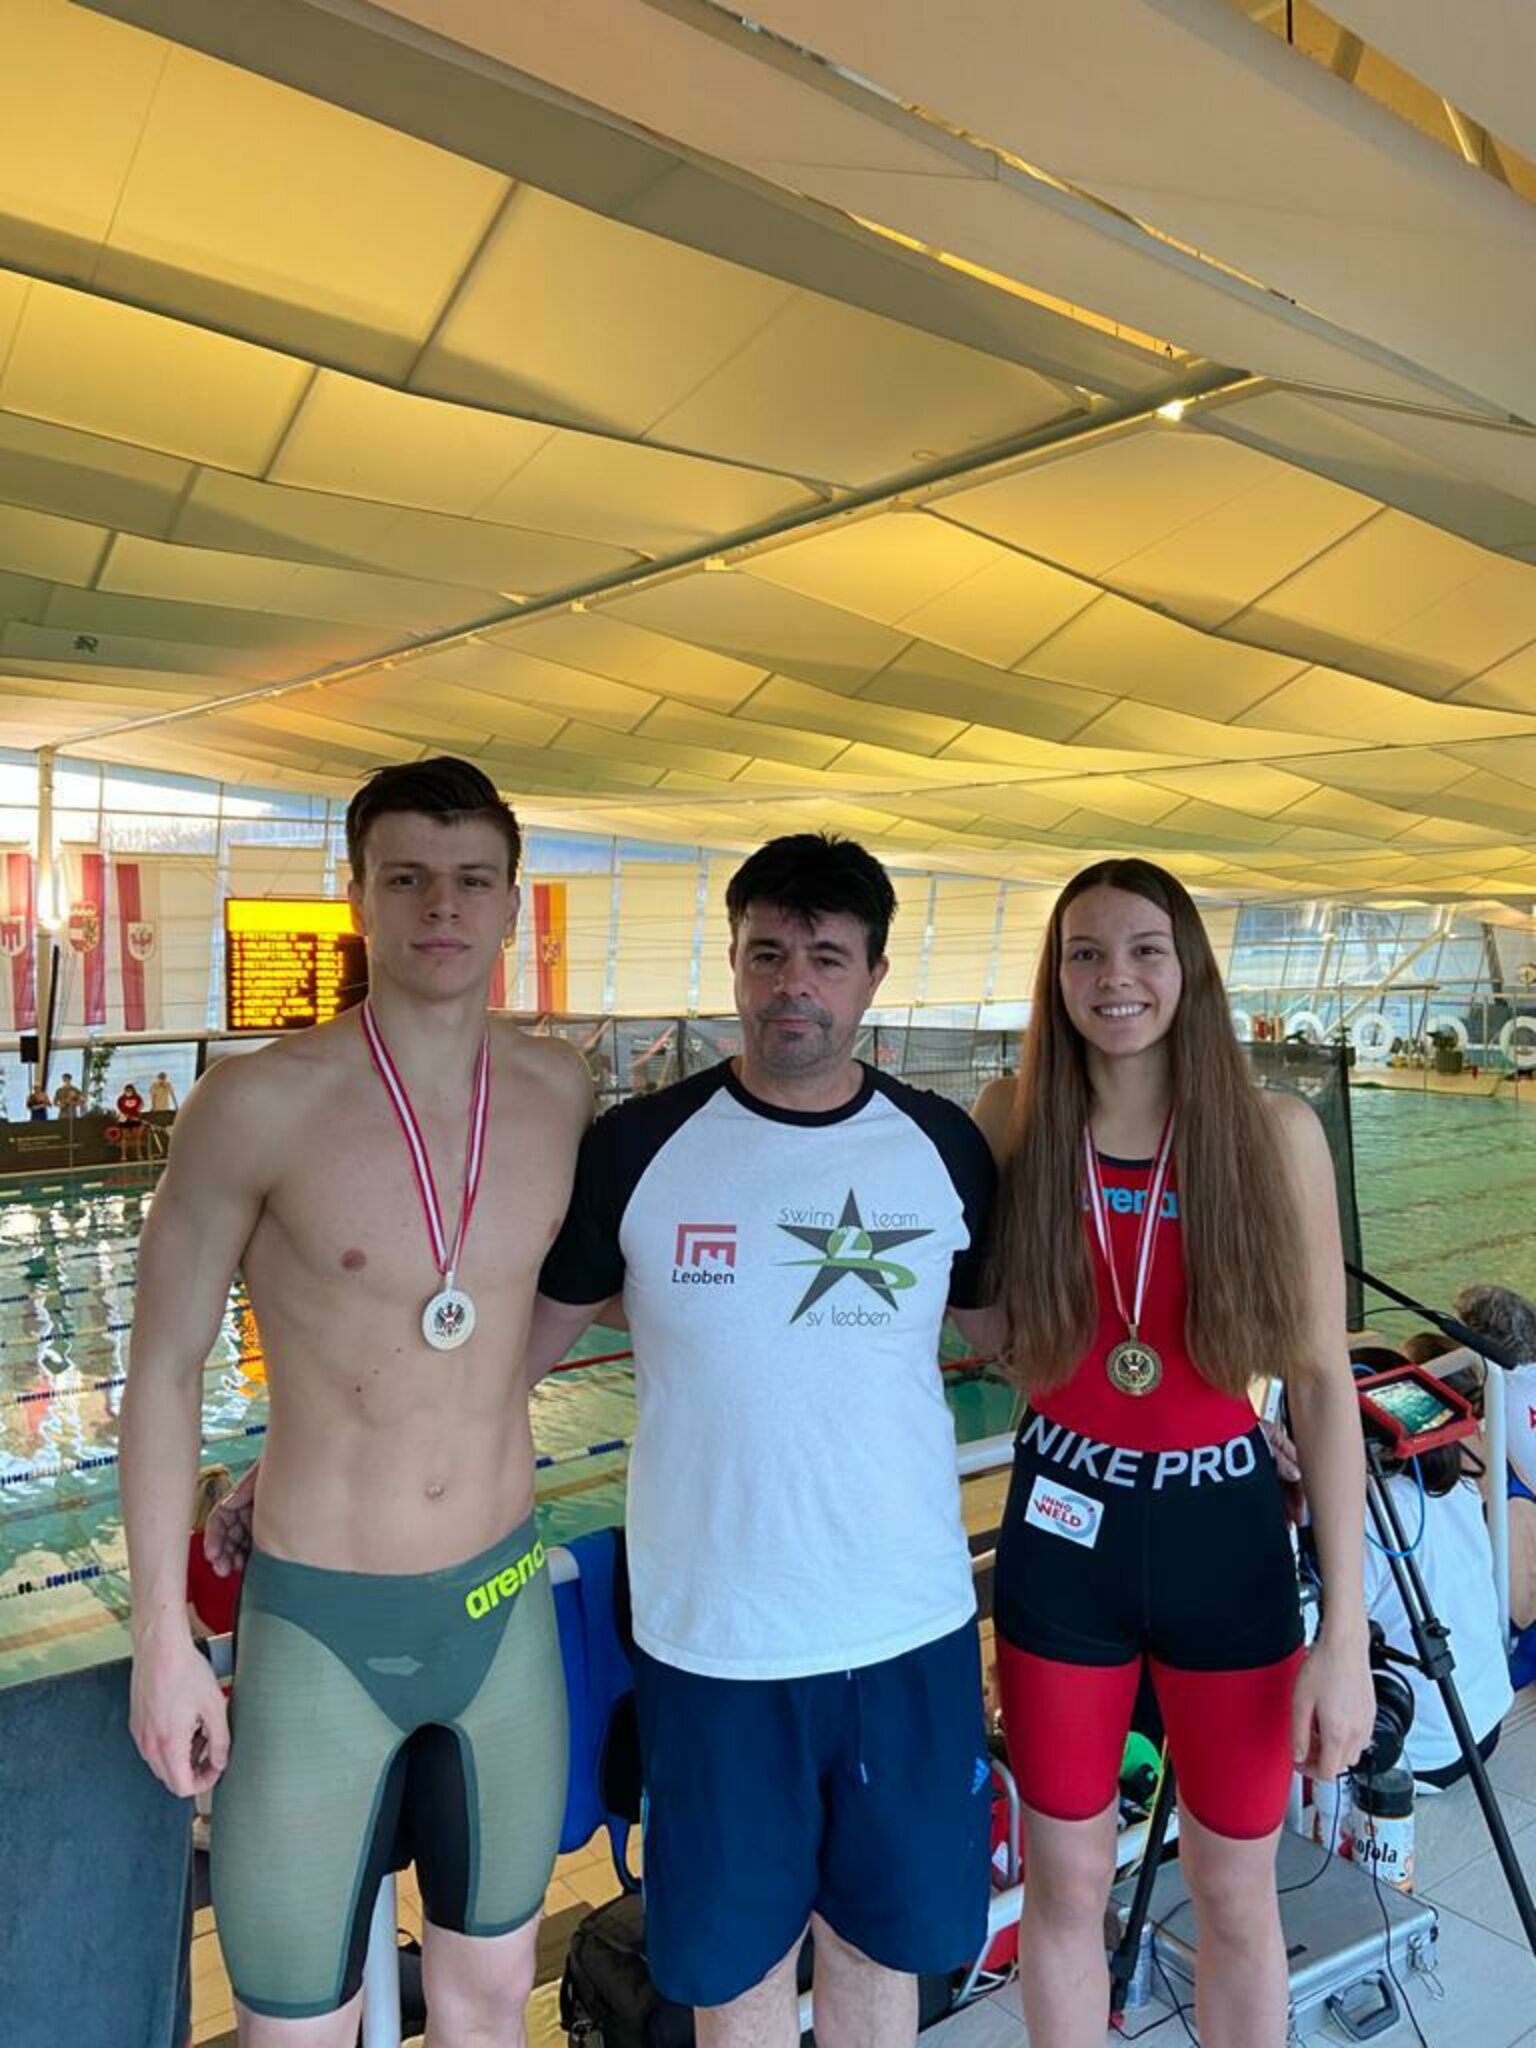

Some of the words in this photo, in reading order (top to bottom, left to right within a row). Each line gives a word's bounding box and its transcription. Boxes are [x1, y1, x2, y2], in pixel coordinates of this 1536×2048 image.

[1100, 1186, 1178, 1218] rena
[778, 1205, 835, 1227] swim
[872, 1210, 919, 1228] team
[671, 1269, 735, 1285] Leoben
[806, 1312, 825, 1327] sv
[831, 1304, 891, 1327] leoben
[1021, 1414, 1144, 1488] NIKE
[1152, 1435, 1257, 1490] PRO
[1034, 1499, 1083, 1527] WELD
[465, 1540, 545, 1619] arena
[1355, 1839, 1398, 1863] ofola
